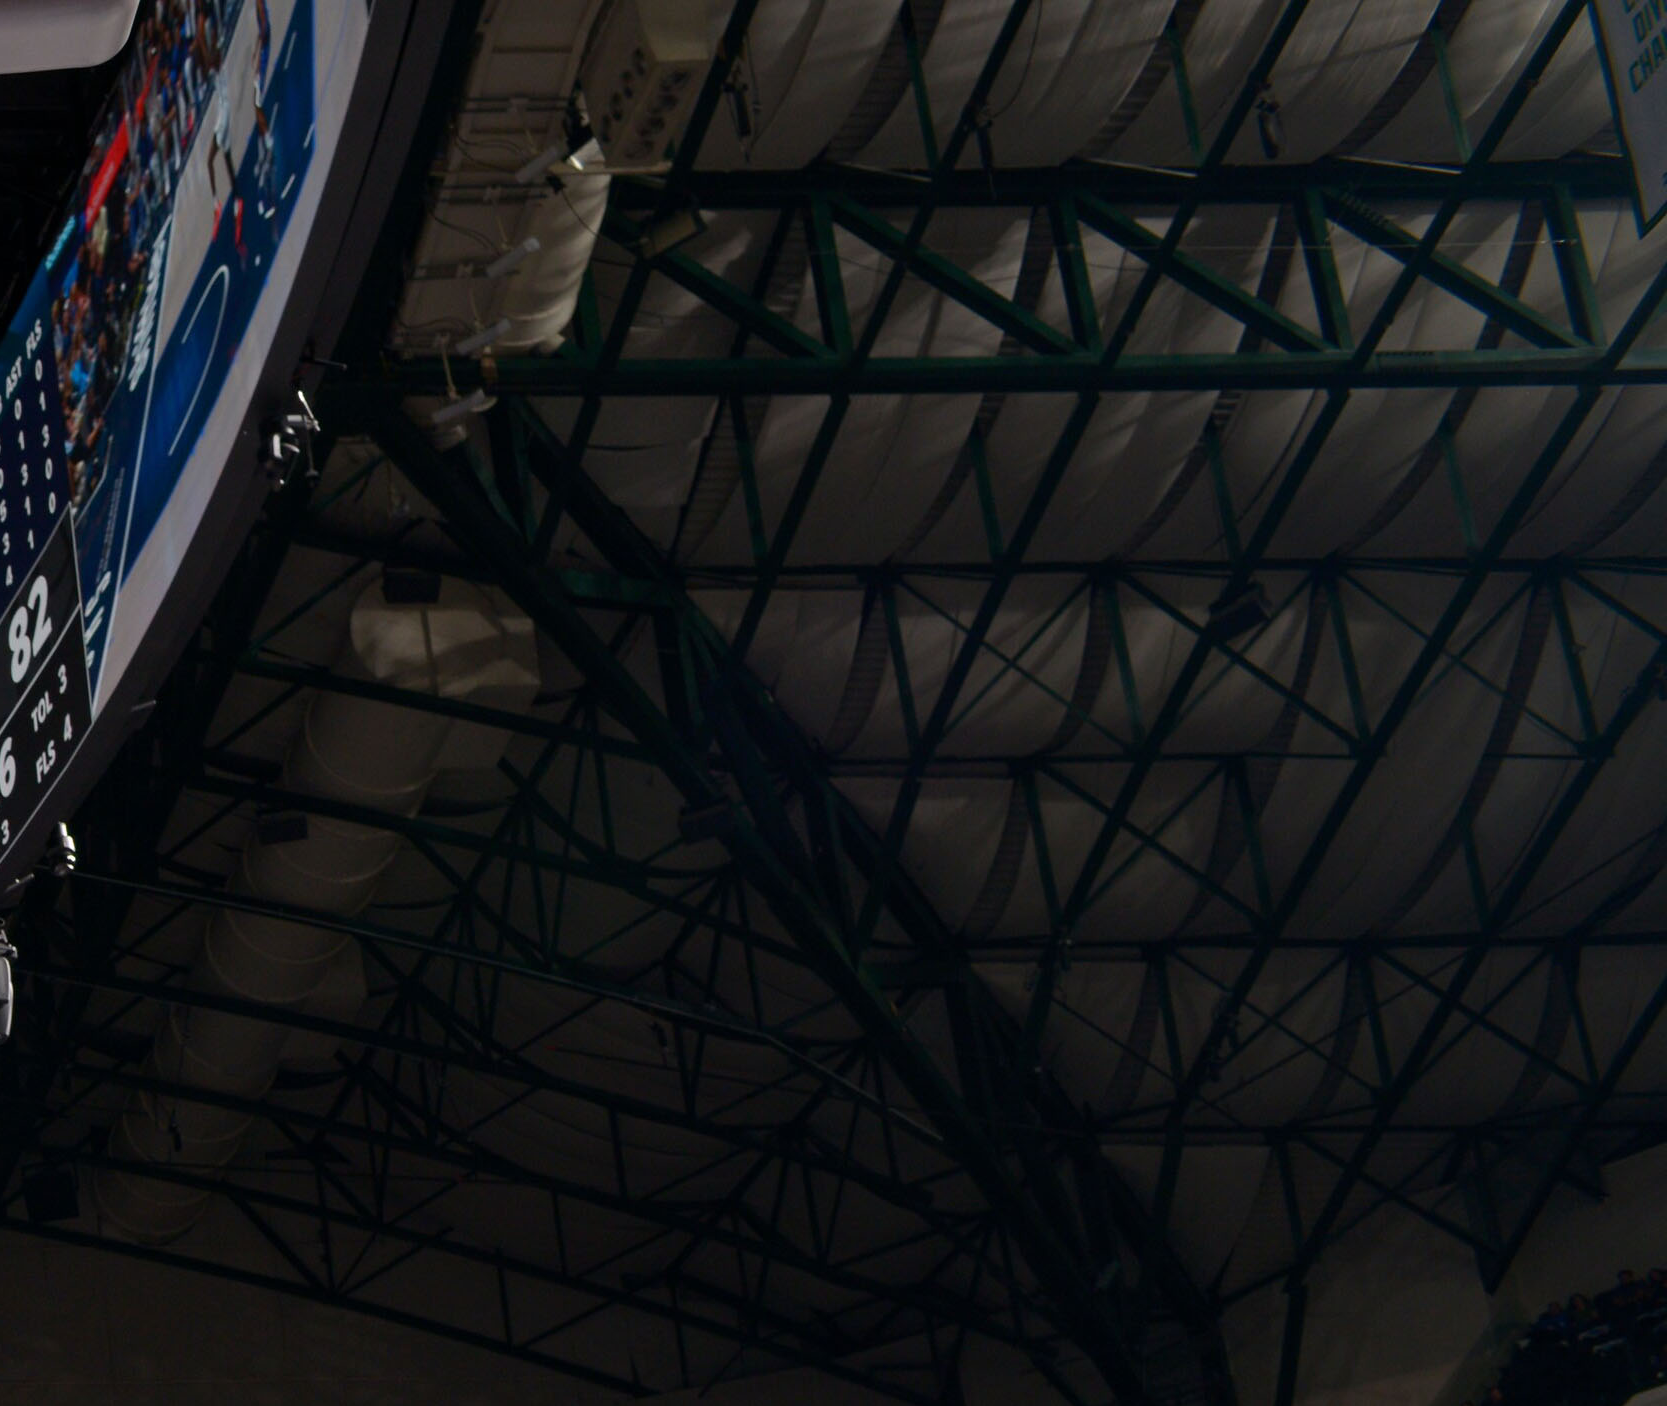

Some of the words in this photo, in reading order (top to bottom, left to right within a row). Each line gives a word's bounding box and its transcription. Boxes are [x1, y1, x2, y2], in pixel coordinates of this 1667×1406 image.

[8, 576, 52, 683] 82
[31, 692, 52, 732] TOL
[58, 665, 67, 693] 3
[36, 740, 56, 782] FLS
[64, 714, 72, 741] 4
